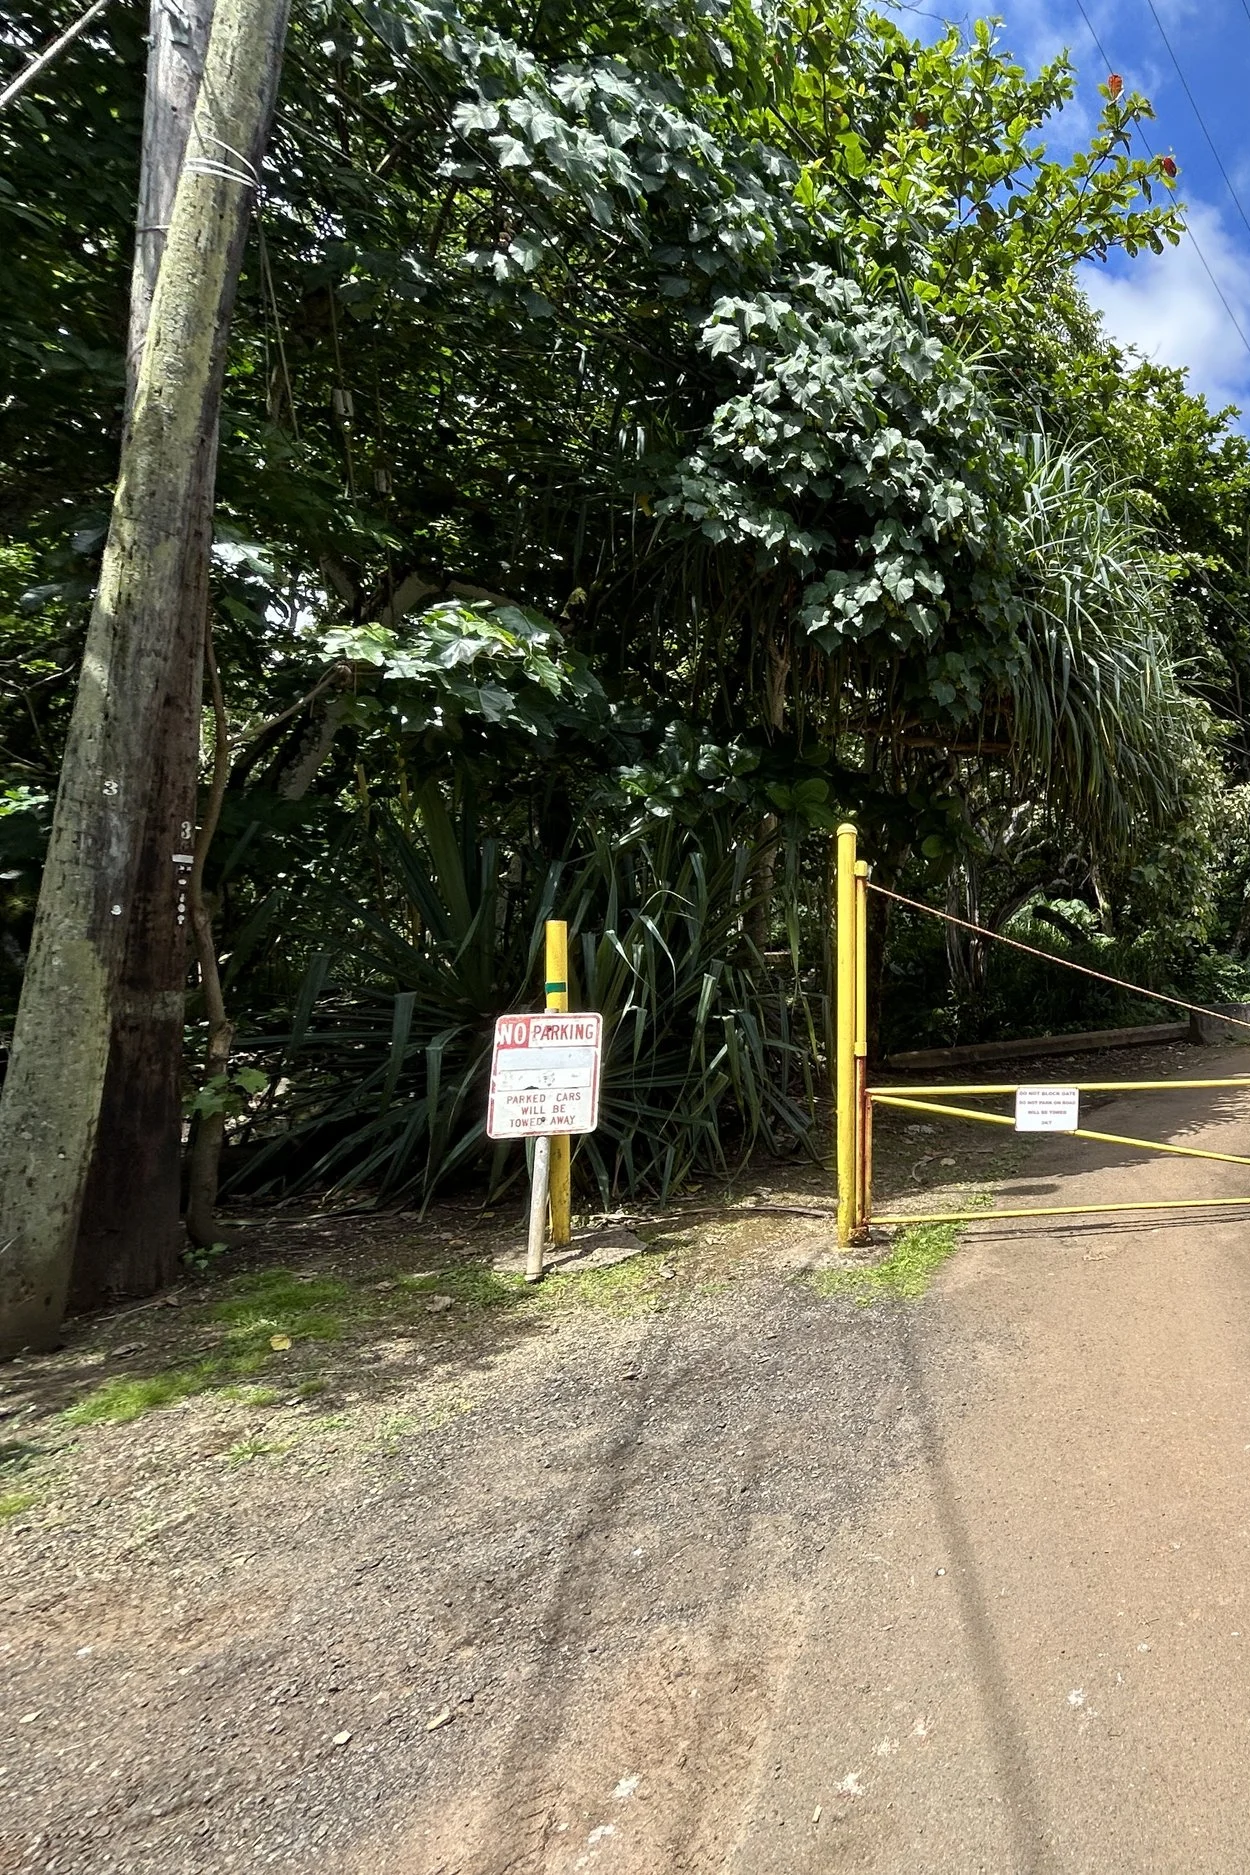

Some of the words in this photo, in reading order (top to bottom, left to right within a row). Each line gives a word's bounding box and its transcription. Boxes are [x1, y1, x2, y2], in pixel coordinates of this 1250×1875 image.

[102, 780, 119, 796] 3
[181, 821, 191, 839] 3
[500, 1022, 527, 1045] NO
[533, 1024, 594, 1041] PARKING
[506, 1094, 546, 1104] PARKED
[556, 1092, 581, 1102] CARS
[521, 1106, 546, 1115] WILL
[552, 1104, 566, 1113] BE
[510, 1117, 545, 1127] TOWED
[550, 1116, 576, 1125] AWAY
